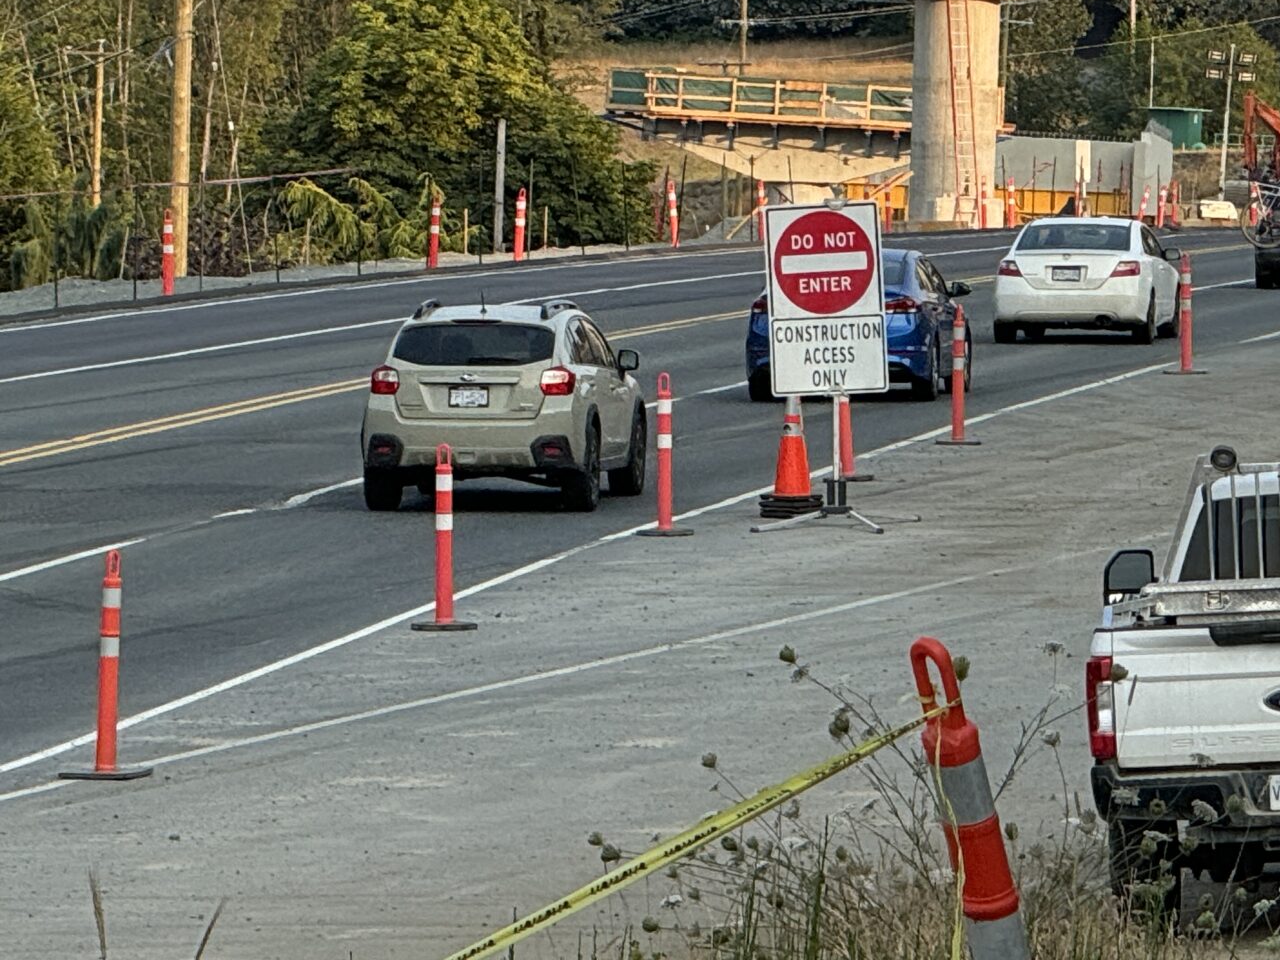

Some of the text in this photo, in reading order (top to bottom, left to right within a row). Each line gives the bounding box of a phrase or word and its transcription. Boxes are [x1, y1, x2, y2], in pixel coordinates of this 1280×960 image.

[791, 232, 856, 250] DO NOT
[799, 276, 852, 293] ENTER
[775, 323, 881, 343] CONSTRUCTION
[804, 347, 855, 365] ACCESS
[812, 369, 848, 387] ONLY
